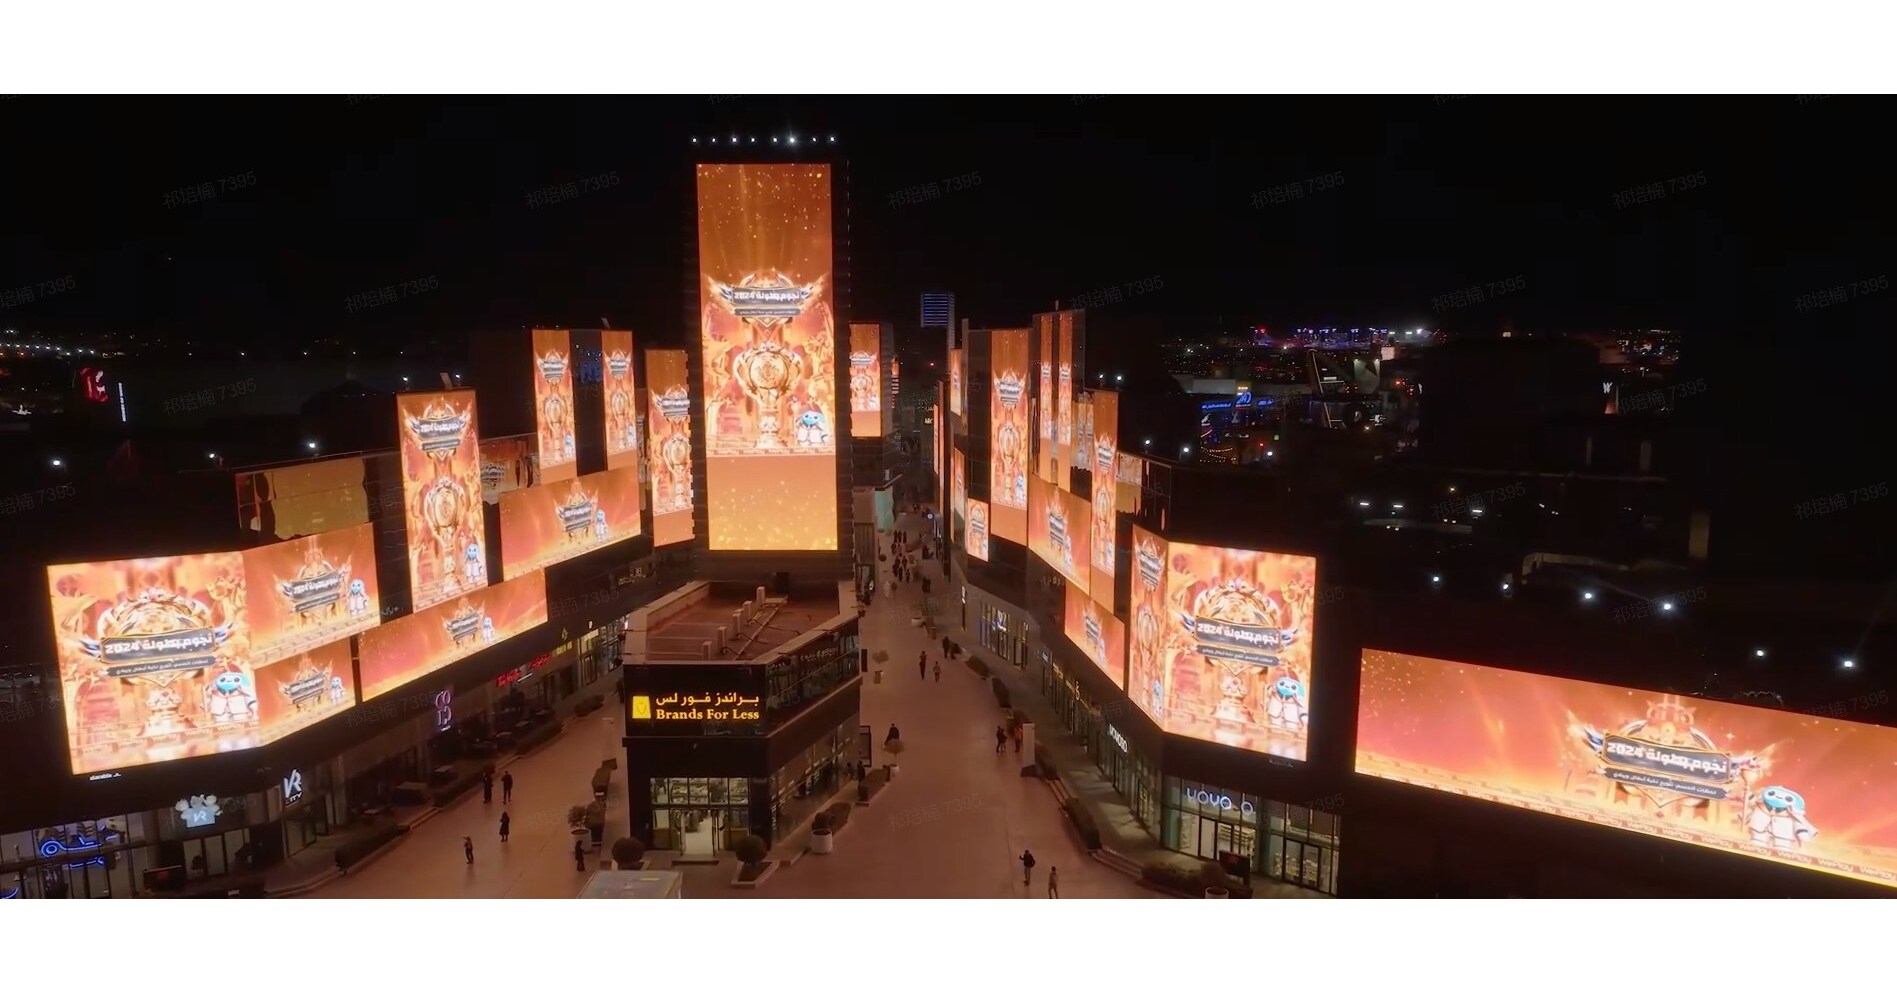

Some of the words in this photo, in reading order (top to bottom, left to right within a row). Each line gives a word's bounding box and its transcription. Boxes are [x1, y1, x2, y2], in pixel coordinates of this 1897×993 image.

[734, 290, 754, 300] 2024
[1198, 622, 1222, 635] 2024
[106, 640, 140, 654] 2024
[656, 692, 678, 706] لس
[681, 692, 711, 706] فور
[656, 708, 704, 720] Brands
[706, 709, 729, 720] For
[732, 709, 760, 720] Less
[1606, 742, 1643, 758] 2024
[284, 768, 302, 798] VR
